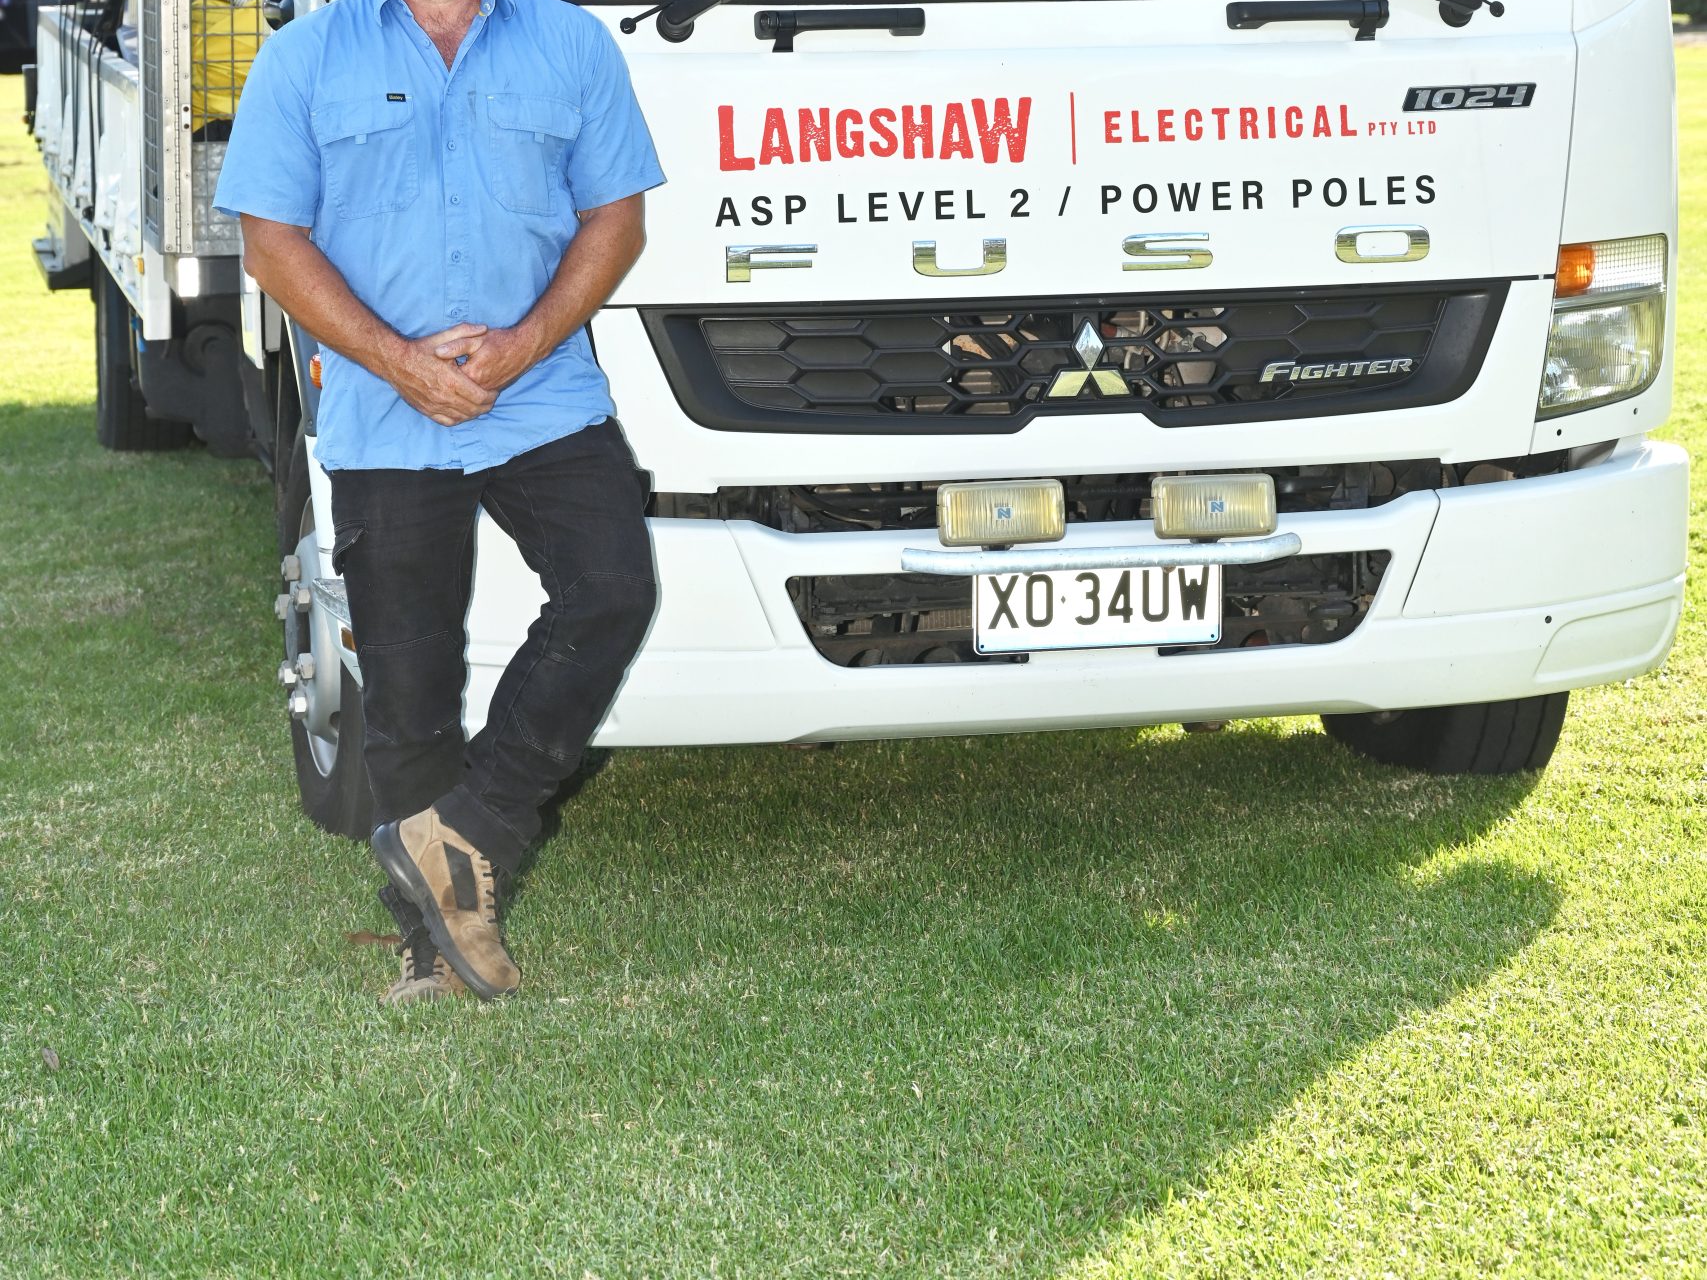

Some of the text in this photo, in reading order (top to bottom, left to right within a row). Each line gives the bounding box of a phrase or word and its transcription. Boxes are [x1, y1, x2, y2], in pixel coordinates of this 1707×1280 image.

[1413, 85, 1528, 110] 1024
[718, 97, 1437, 172] LANGSHAW ELECTRICAL PTY LTD
[715, 195, 807, 227] ASP
[837, 189, 986, 223] LEVEL
[1010, 188, 1030, 218] 2
[1101, 180, 1263, 215] POWER
[1292, 174, 1436, 209] POLES
[724, 224, 1431, 284] FUSO
